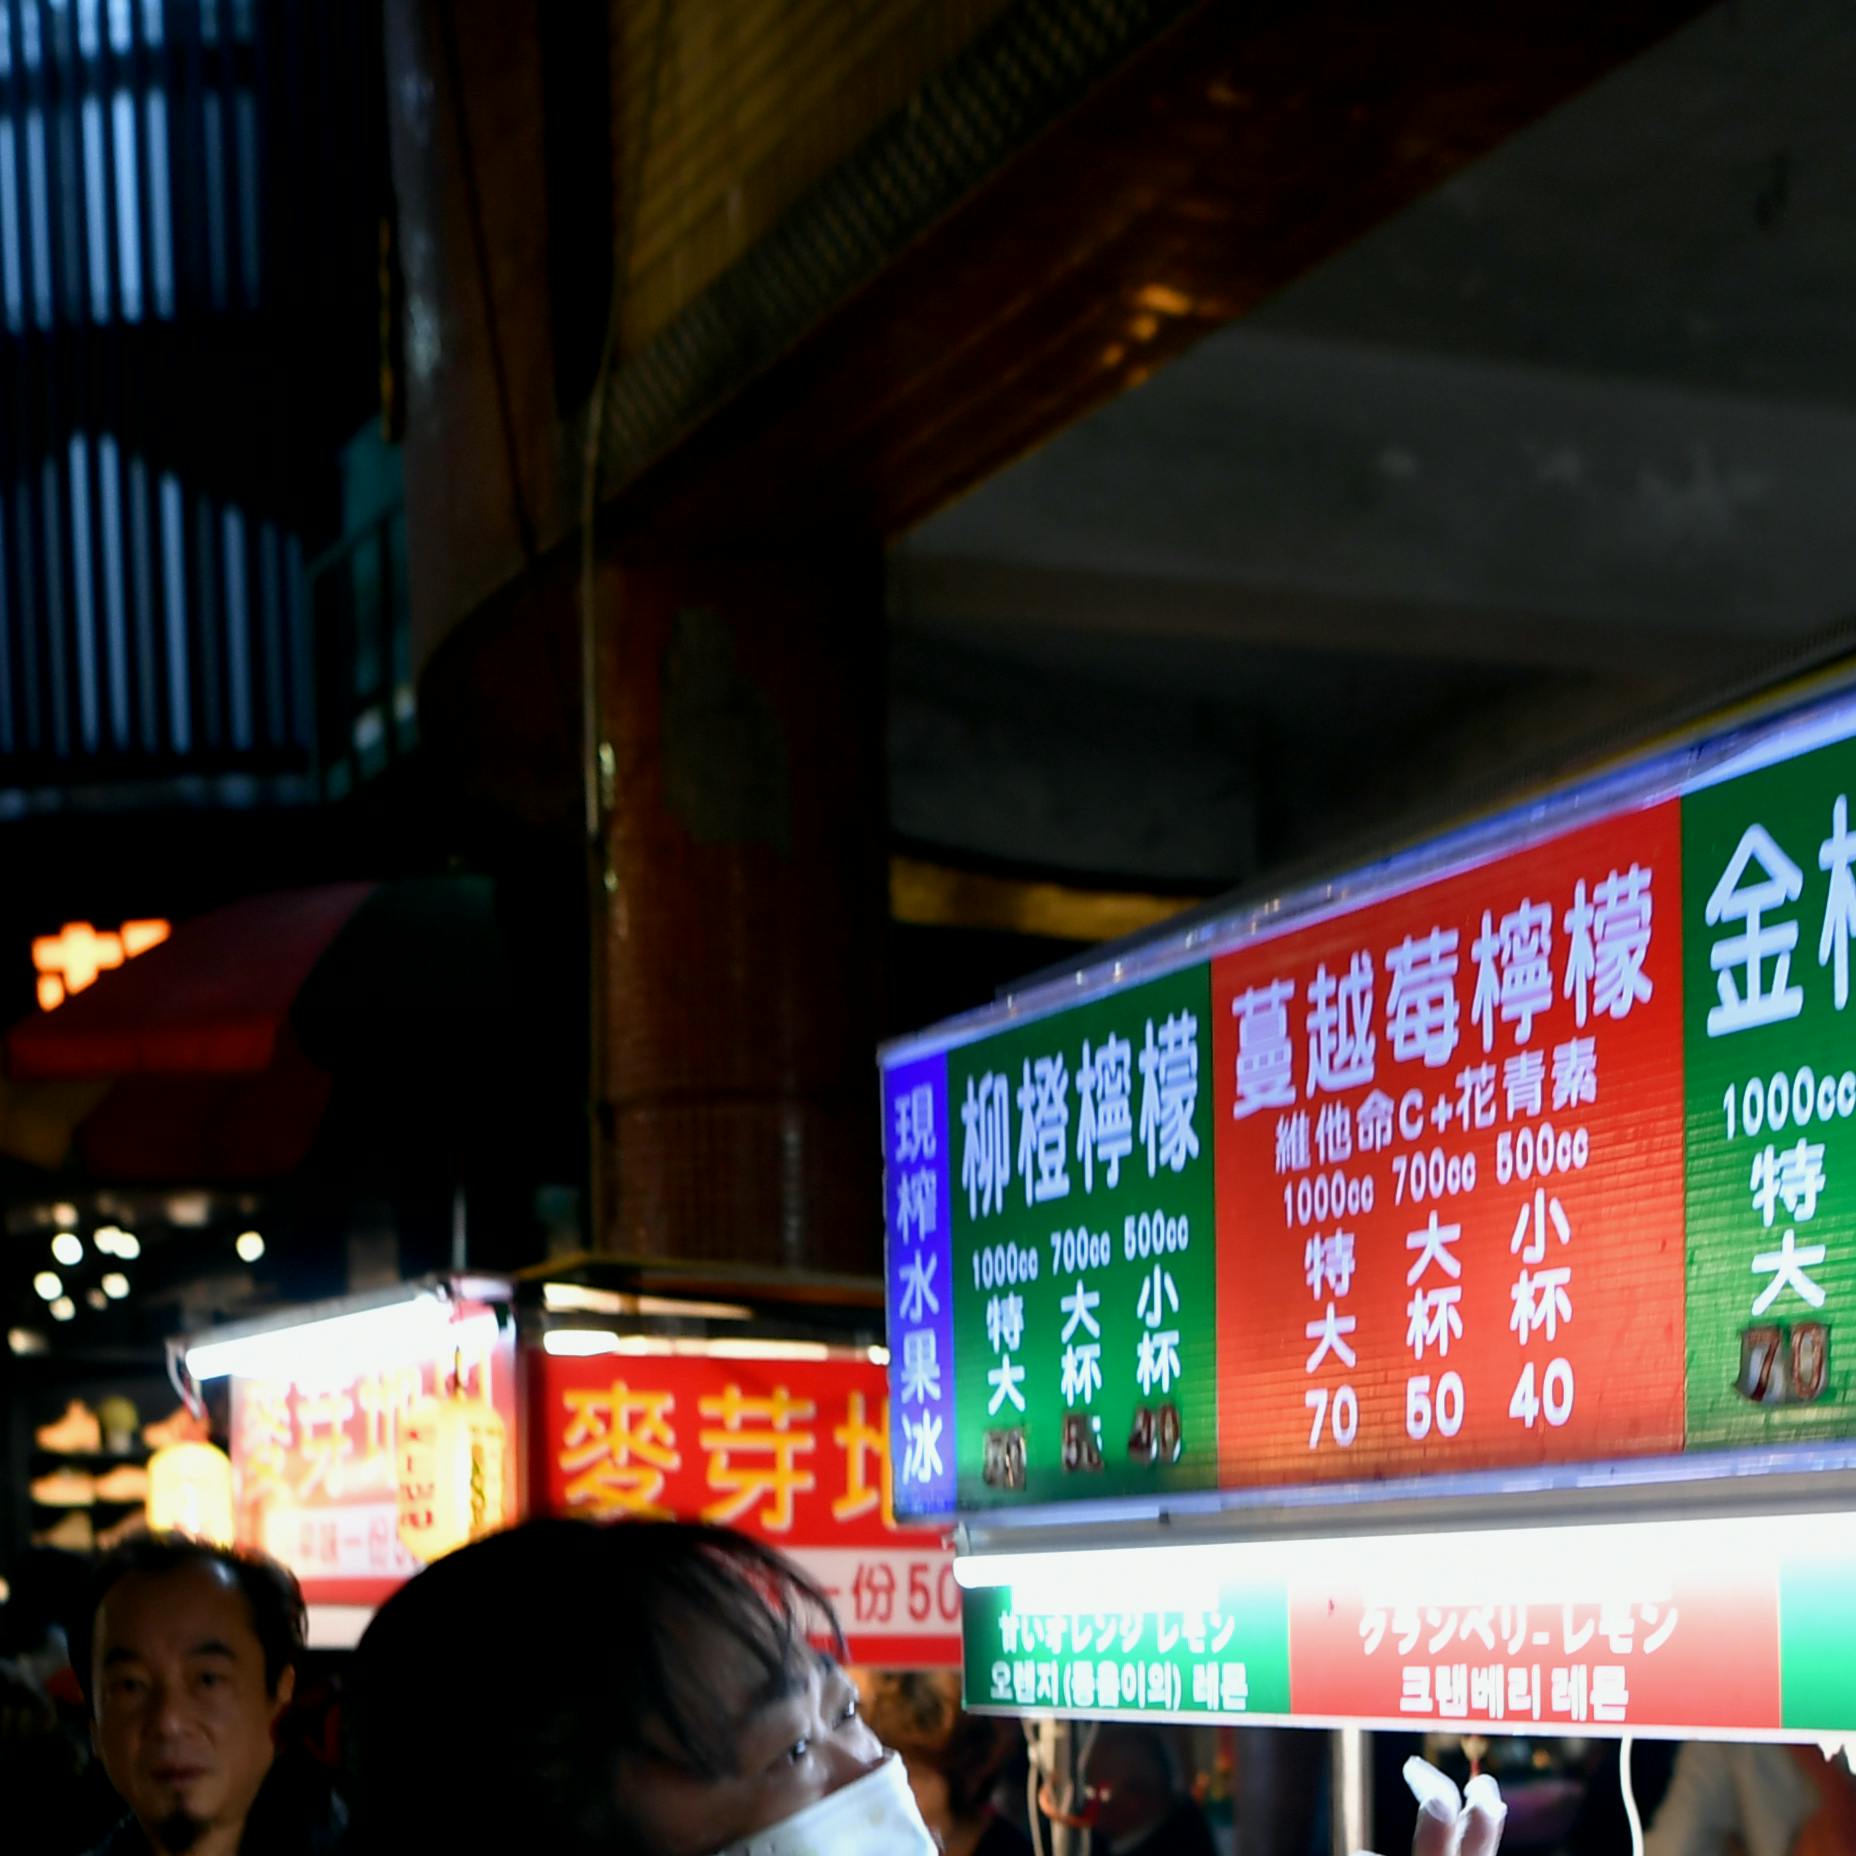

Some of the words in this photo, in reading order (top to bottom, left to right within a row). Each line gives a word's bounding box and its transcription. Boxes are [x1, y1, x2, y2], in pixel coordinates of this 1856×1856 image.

[1231, 860, 1655, 1119] 蔓越莓檸檬
[960, 1008, 1199, 1221] 柳橙檸檬
[1274, 1036, 1598, 1176] 維他命C+花青素
[1721, 1064, 1856, 1139] 1000cc
[1284, 1169, 1374, 1229] 1000cc
[1392, 1146, 1476, 1206] 700cc
[1496, 1121, 1589, 1185] 500cc
[1749, 1138, 1827, 1317] 特大
[894, 1084, 942, 1485] 現榨水果冰
[1137, 1263, 1180, 1396] 小杯
[1305, 1227, 1356, 1374] 特大
[1406, 1209, 1463, 1361] 大杯
[1509, 1187, 1573, 1346] 小杯
[986, 1291, 1025, 1416] 特大
[1061, 1279, 1102, 1408] 大杯
[1304, 1385, 1358, 1450] 70
[1406, 1370, 1464, 1440] 50
[1509, 1357, 1575, 1428] 40
[1742, 1322, 1829, 1401] 70
